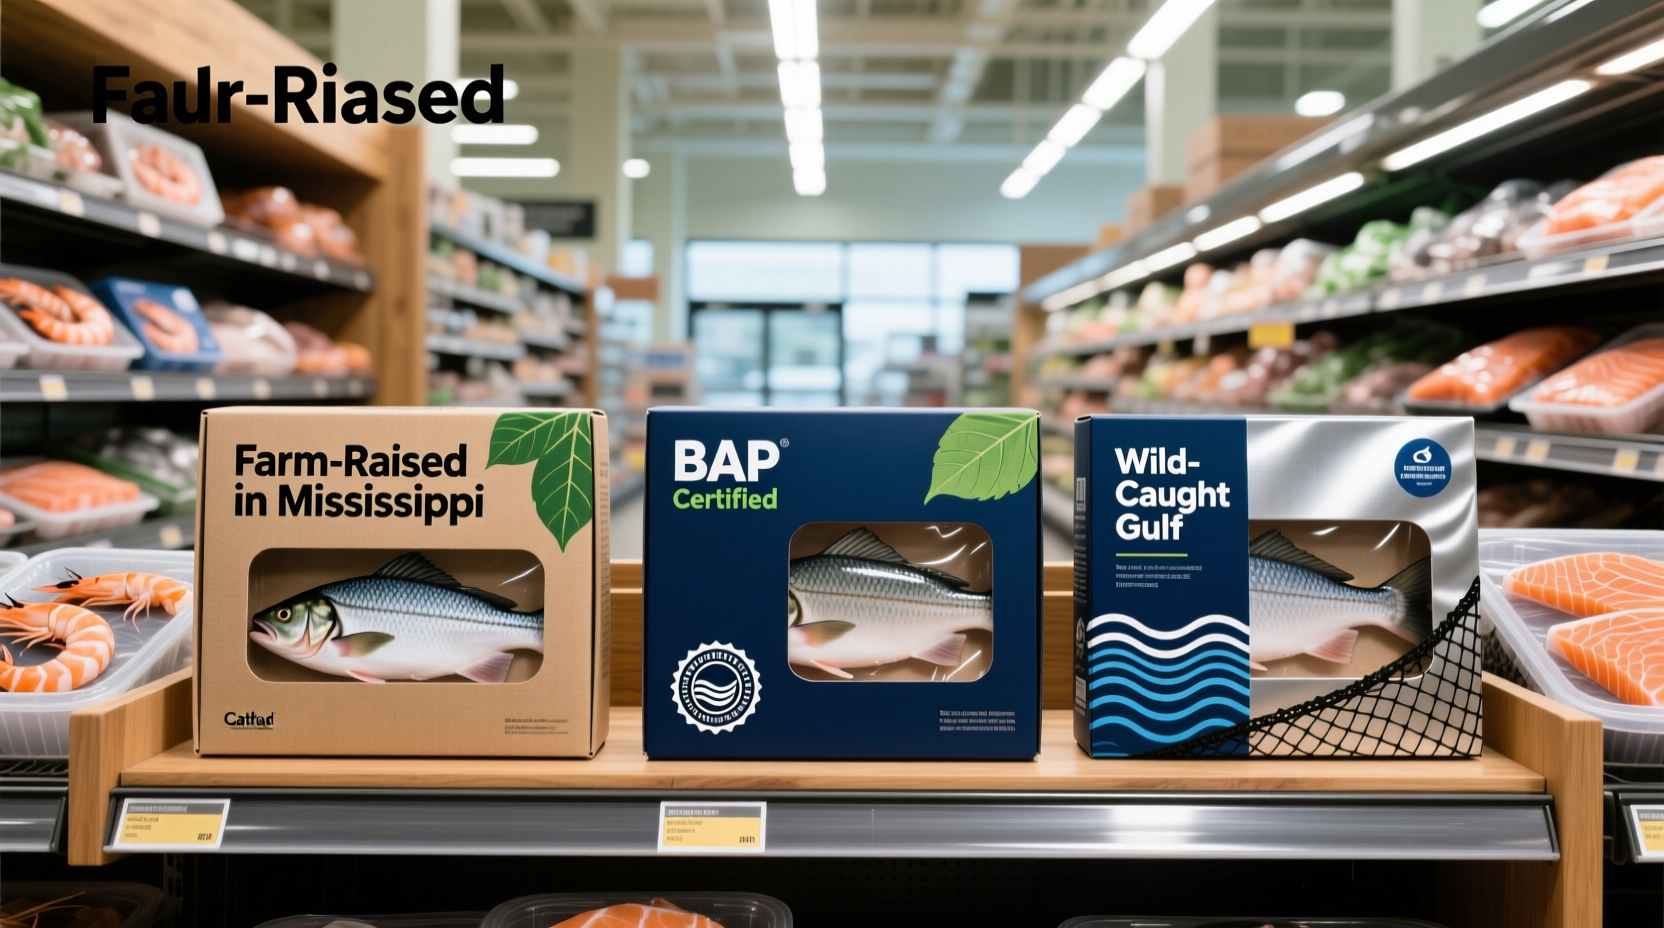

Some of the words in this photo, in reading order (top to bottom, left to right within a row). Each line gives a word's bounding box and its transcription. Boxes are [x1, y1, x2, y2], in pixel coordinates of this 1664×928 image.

[234, 443, 467, 478] Farm-Raised
[1114, 446, 1200, 475] Wild-
[234, 482, 267, 517] in
[278, 482, 485, 526] Mississippi
[672, 486, 778, 510] Certified
[1115, 479, 1231, 515] Caught
[1115, 512, 1184, 541] Gulf
